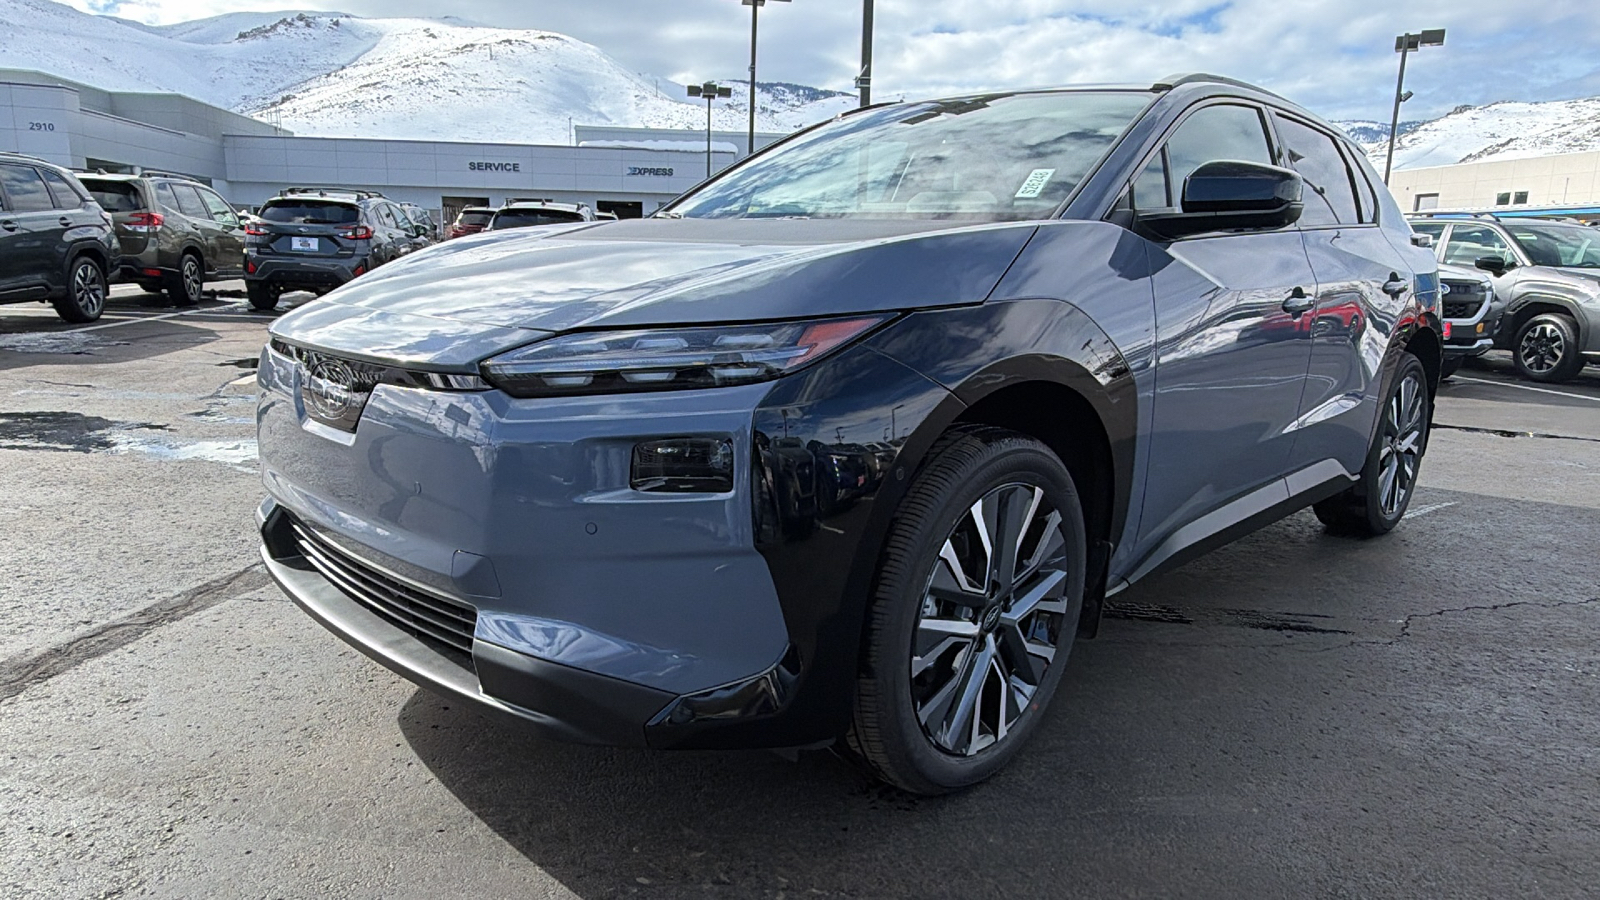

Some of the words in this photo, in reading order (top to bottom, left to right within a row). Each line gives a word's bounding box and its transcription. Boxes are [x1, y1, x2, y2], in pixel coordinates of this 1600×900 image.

[29, 121, 55, 132] 2910
[468, 161, 521, 172] SERVICE
[626, 166, 674, 177] EXPRESS
